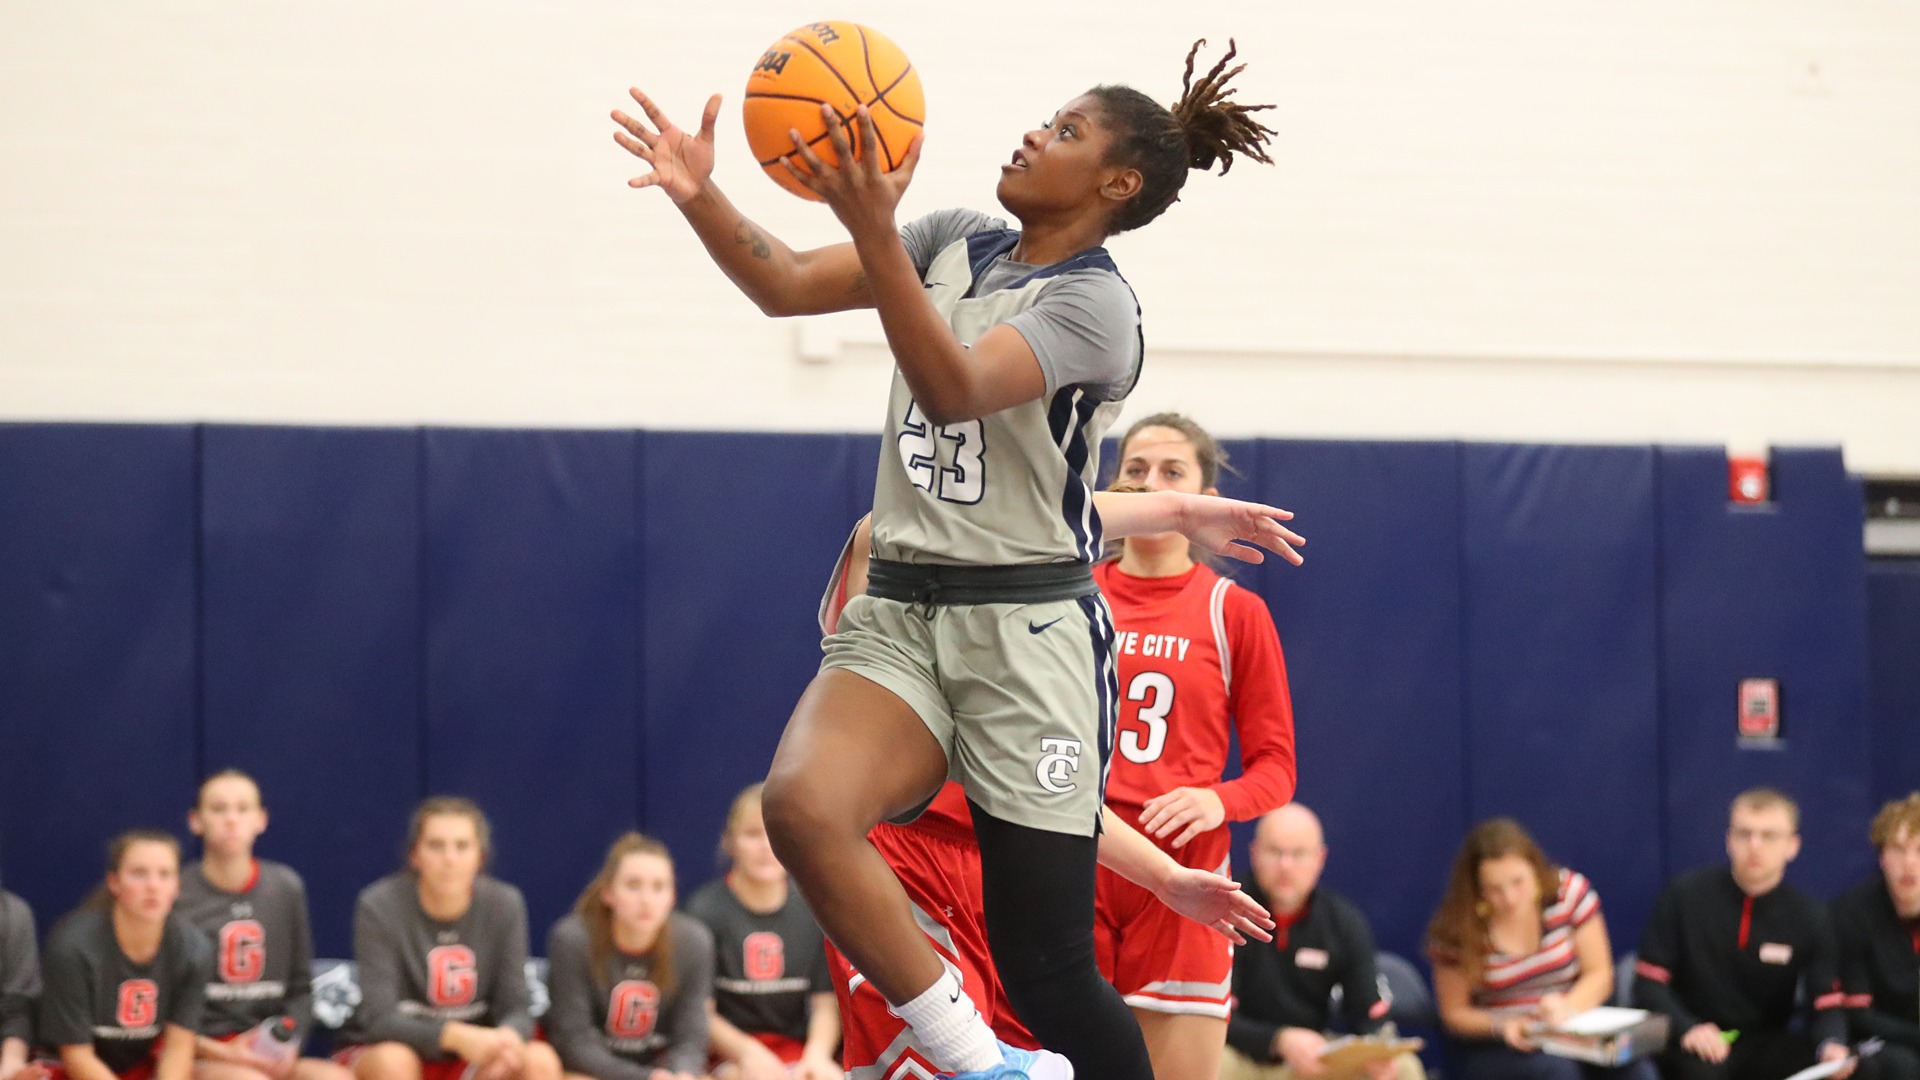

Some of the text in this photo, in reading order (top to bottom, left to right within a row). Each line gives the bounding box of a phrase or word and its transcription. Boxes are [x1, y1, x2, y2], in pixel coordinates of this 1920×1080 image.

[898, 397, 986, 505] 23
[1142, 633, 1190, 662] CITY
[1118, 670, 1176, 764] 3
[218, 919, 266, 983] G
[427, 944, 478, 1007] G
[743, 931, 785, 981] G
[117, 978, 159, 1027] G
[605, 979, 660, 1039] G
